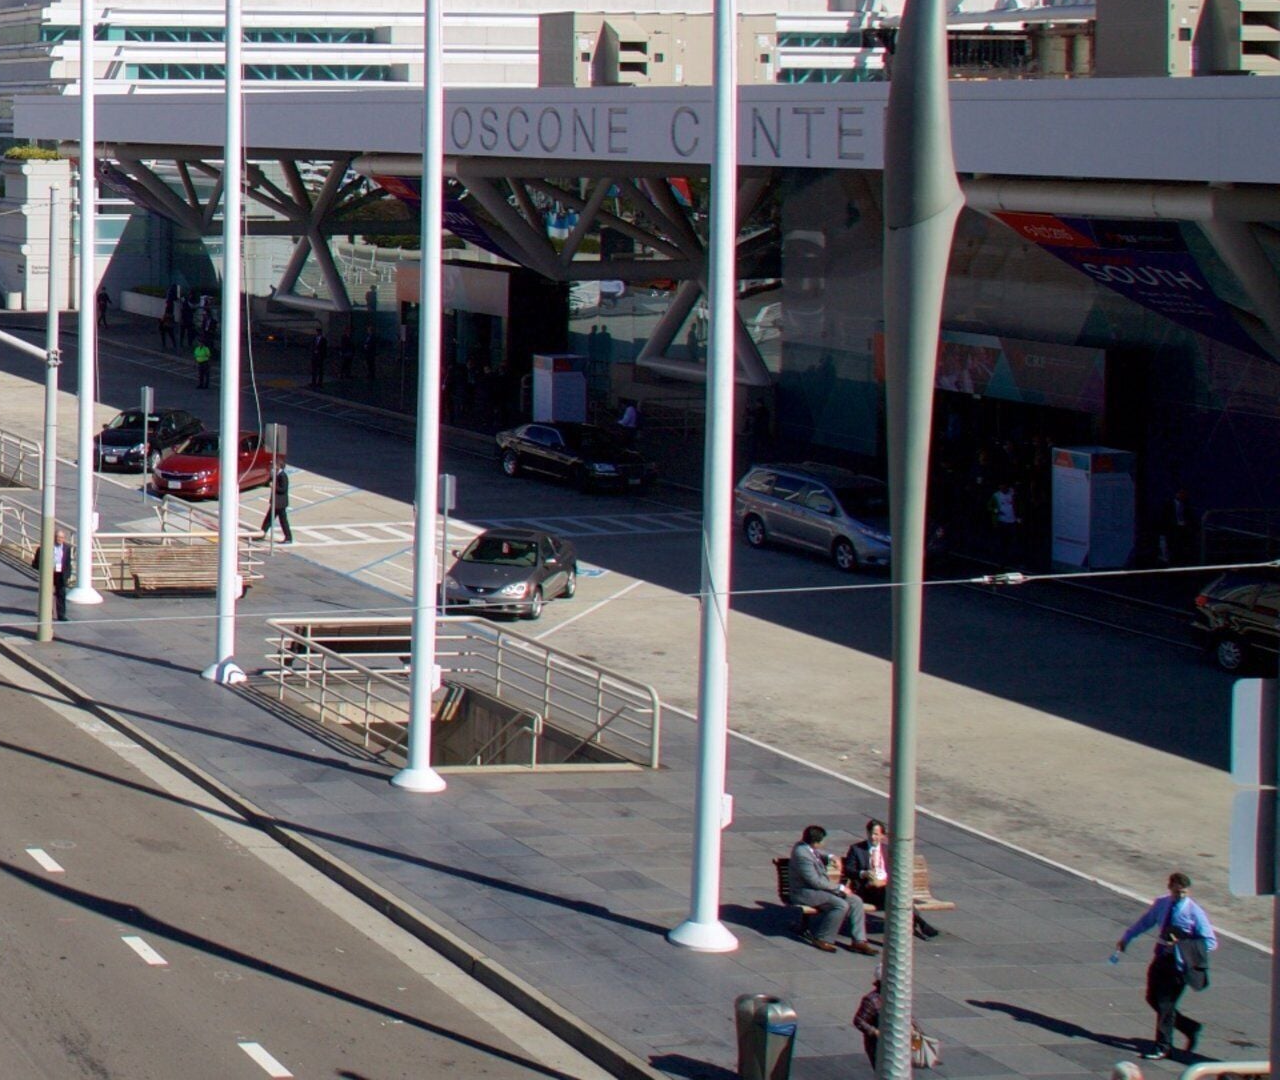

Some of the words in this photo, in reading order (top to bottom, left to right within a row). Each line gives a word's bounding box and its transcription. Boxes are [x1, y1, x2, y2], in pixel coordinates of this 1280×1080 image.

[420, 106, 629, 154] OSCONE
[670, 106, 889, 161] CNTE
[1081, 264, 1203, 290] SOUTH
